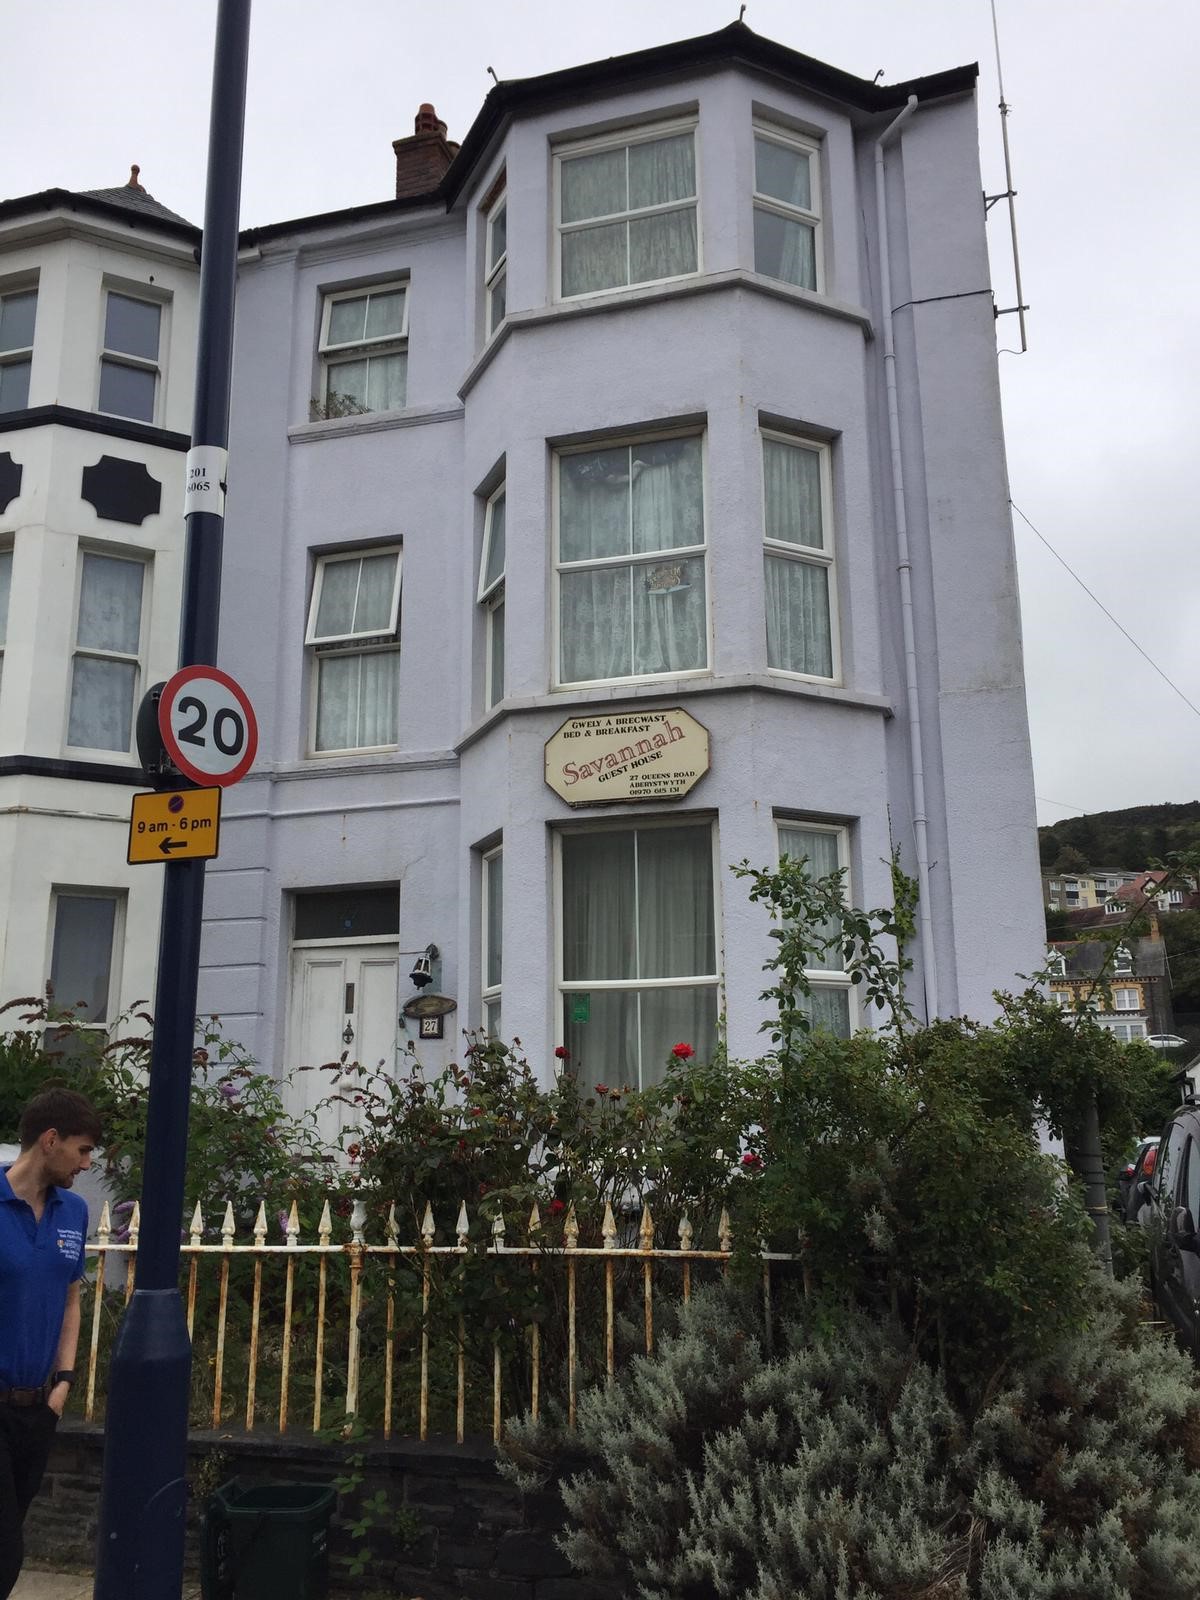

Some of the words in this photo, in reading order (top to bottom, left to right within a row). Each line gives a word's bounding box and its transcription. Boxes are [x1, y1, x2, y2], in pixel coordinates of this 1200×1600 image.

[177, 696, 245, 756] 20
[572, 719, 602, 729] GWELY
[616, 715, 666, 725] BRECWAST
[563, 731, 581, 739] BED
[595, 725, 651, 736] BREAKFAST
[562, 720, 686, 787] Savannah
[598, 765, 628, 783] GUEST
[631, 751, 663, 769] HOUSE
[641, 772, 671, 780] QUEENS
[629, 779, 686, 788] ABERYSTWYTH
[424, 1020, 437, 1033] 27
